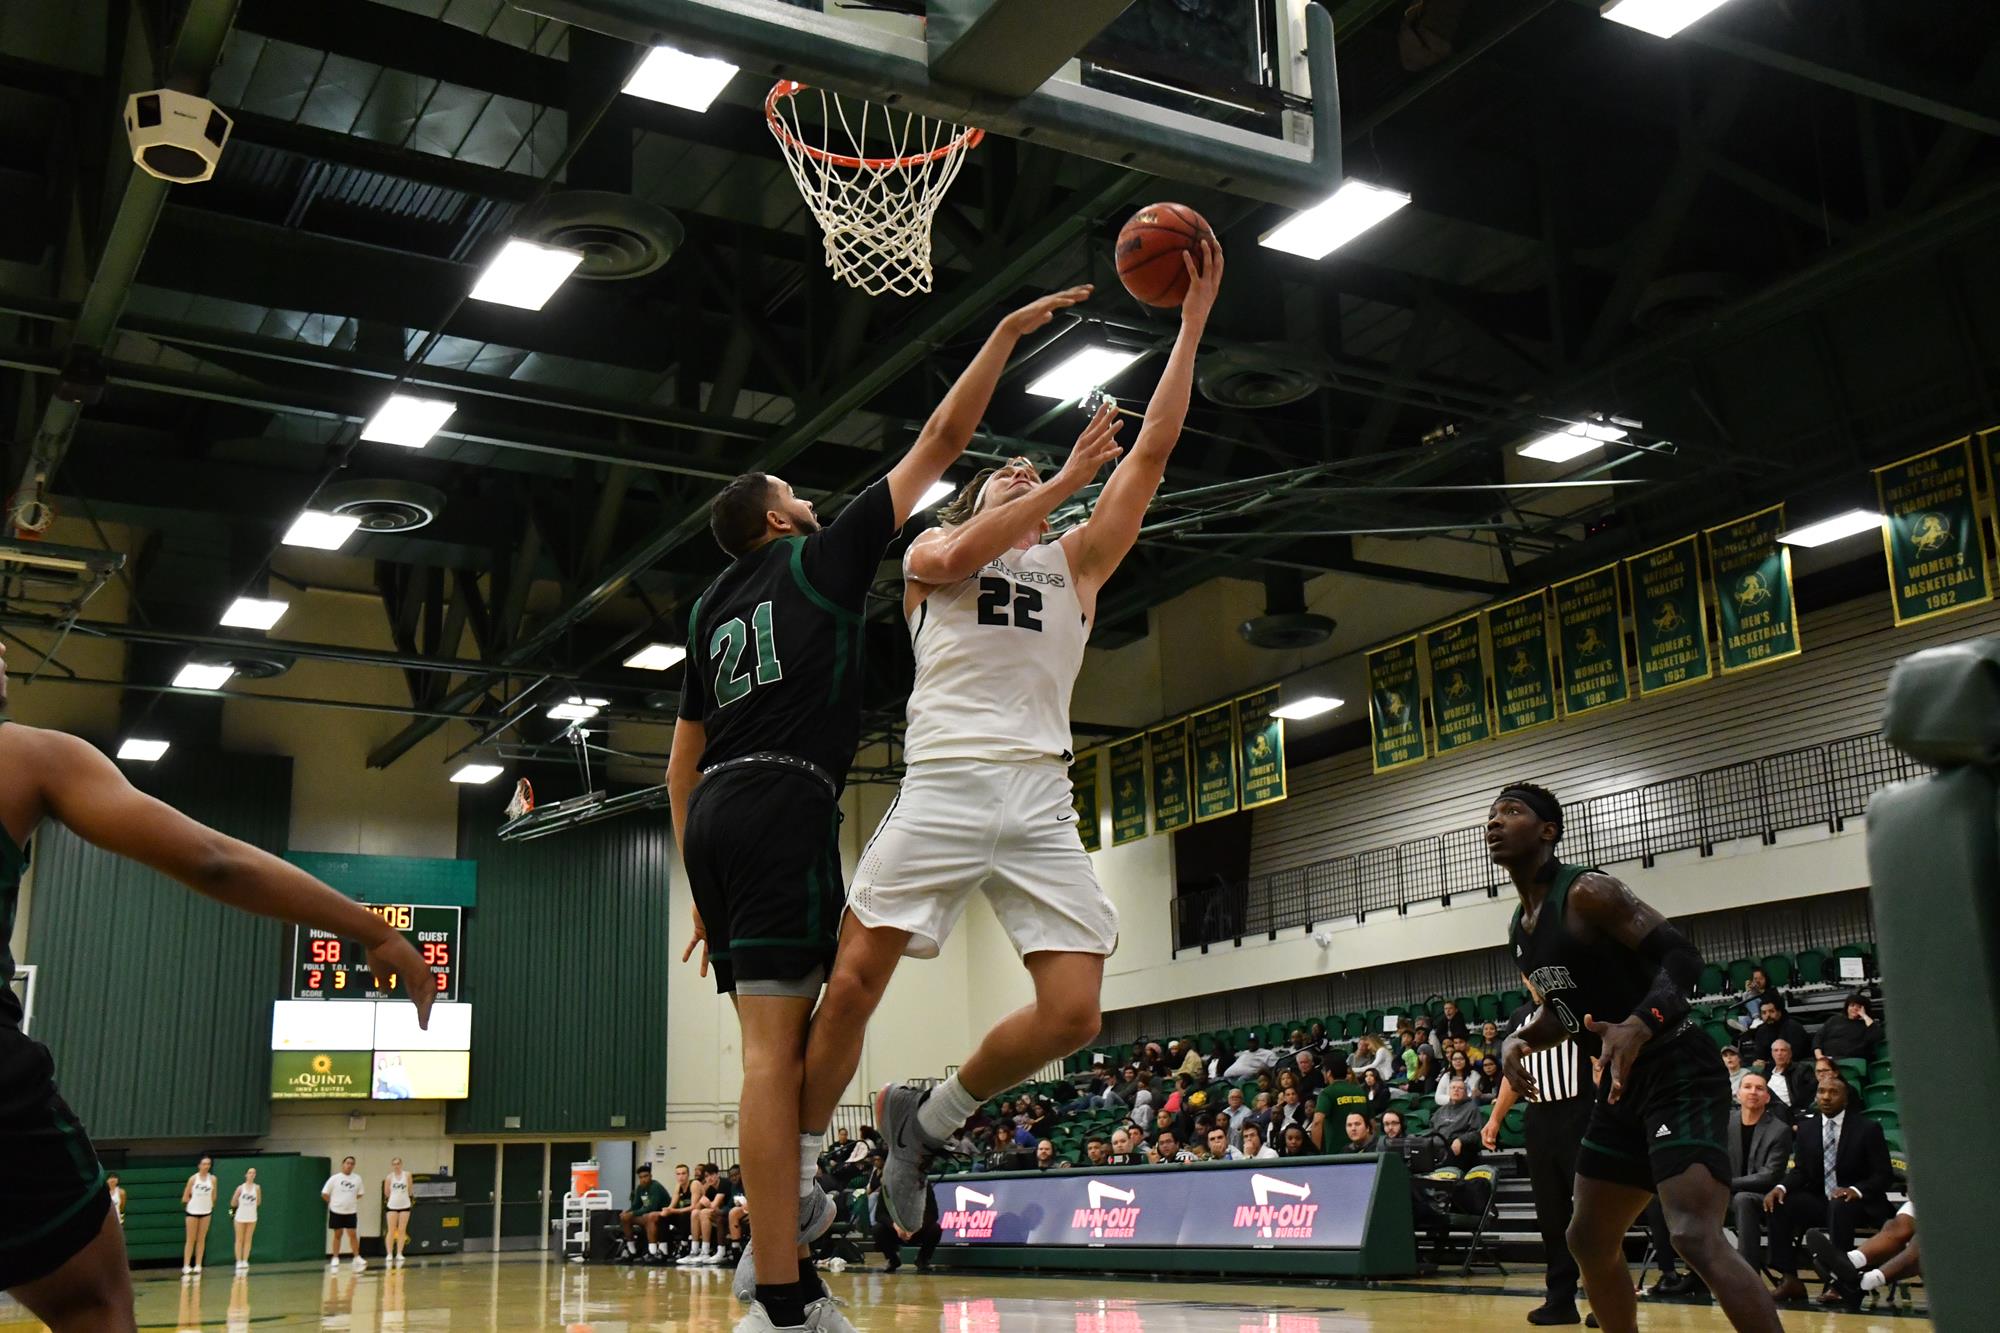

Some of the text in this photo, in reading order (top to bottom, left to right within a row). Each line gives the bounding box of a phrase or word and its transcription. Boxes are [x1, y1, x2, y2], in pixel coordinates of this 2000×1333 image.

[1908, 552, 1965, 579] WOMEN'S
[1903, 567, 1976, 598] BASKETBALL
[977, 577, 1043, 632] 22
[1926, 590, 1957, 609] 1982
[1651, 634, 1694, 657] WOMEN'S
[1728, 622, 1788, 649] BASKETBALL
[710, 601, 783, 709] 21
[1645, 648, 1700, 673] BASKETBALL
[1574, 659, 1614, 680] WOMEN'S
[1570, 673, 1619, 696] BASKETBALL
[1502, 694, 1548, 716] BASKETBALL
[418, 931, 449, 942] GUEST
[312, 940, 341, 963] 58
[423, 943, 449, 965] 35
[303, 963, 325, 971] FOULS
[309, 971, 347, 989] 2 3
[436, 973, 448, 990] 3
[301, 990, 324, 998] SCORE
[299, 1073, 352, 1087] QUINTA
[1233, 1204, 1319, 1227] IN-N-OUT
[1274, 1227, 1313, 1238] BURGER
